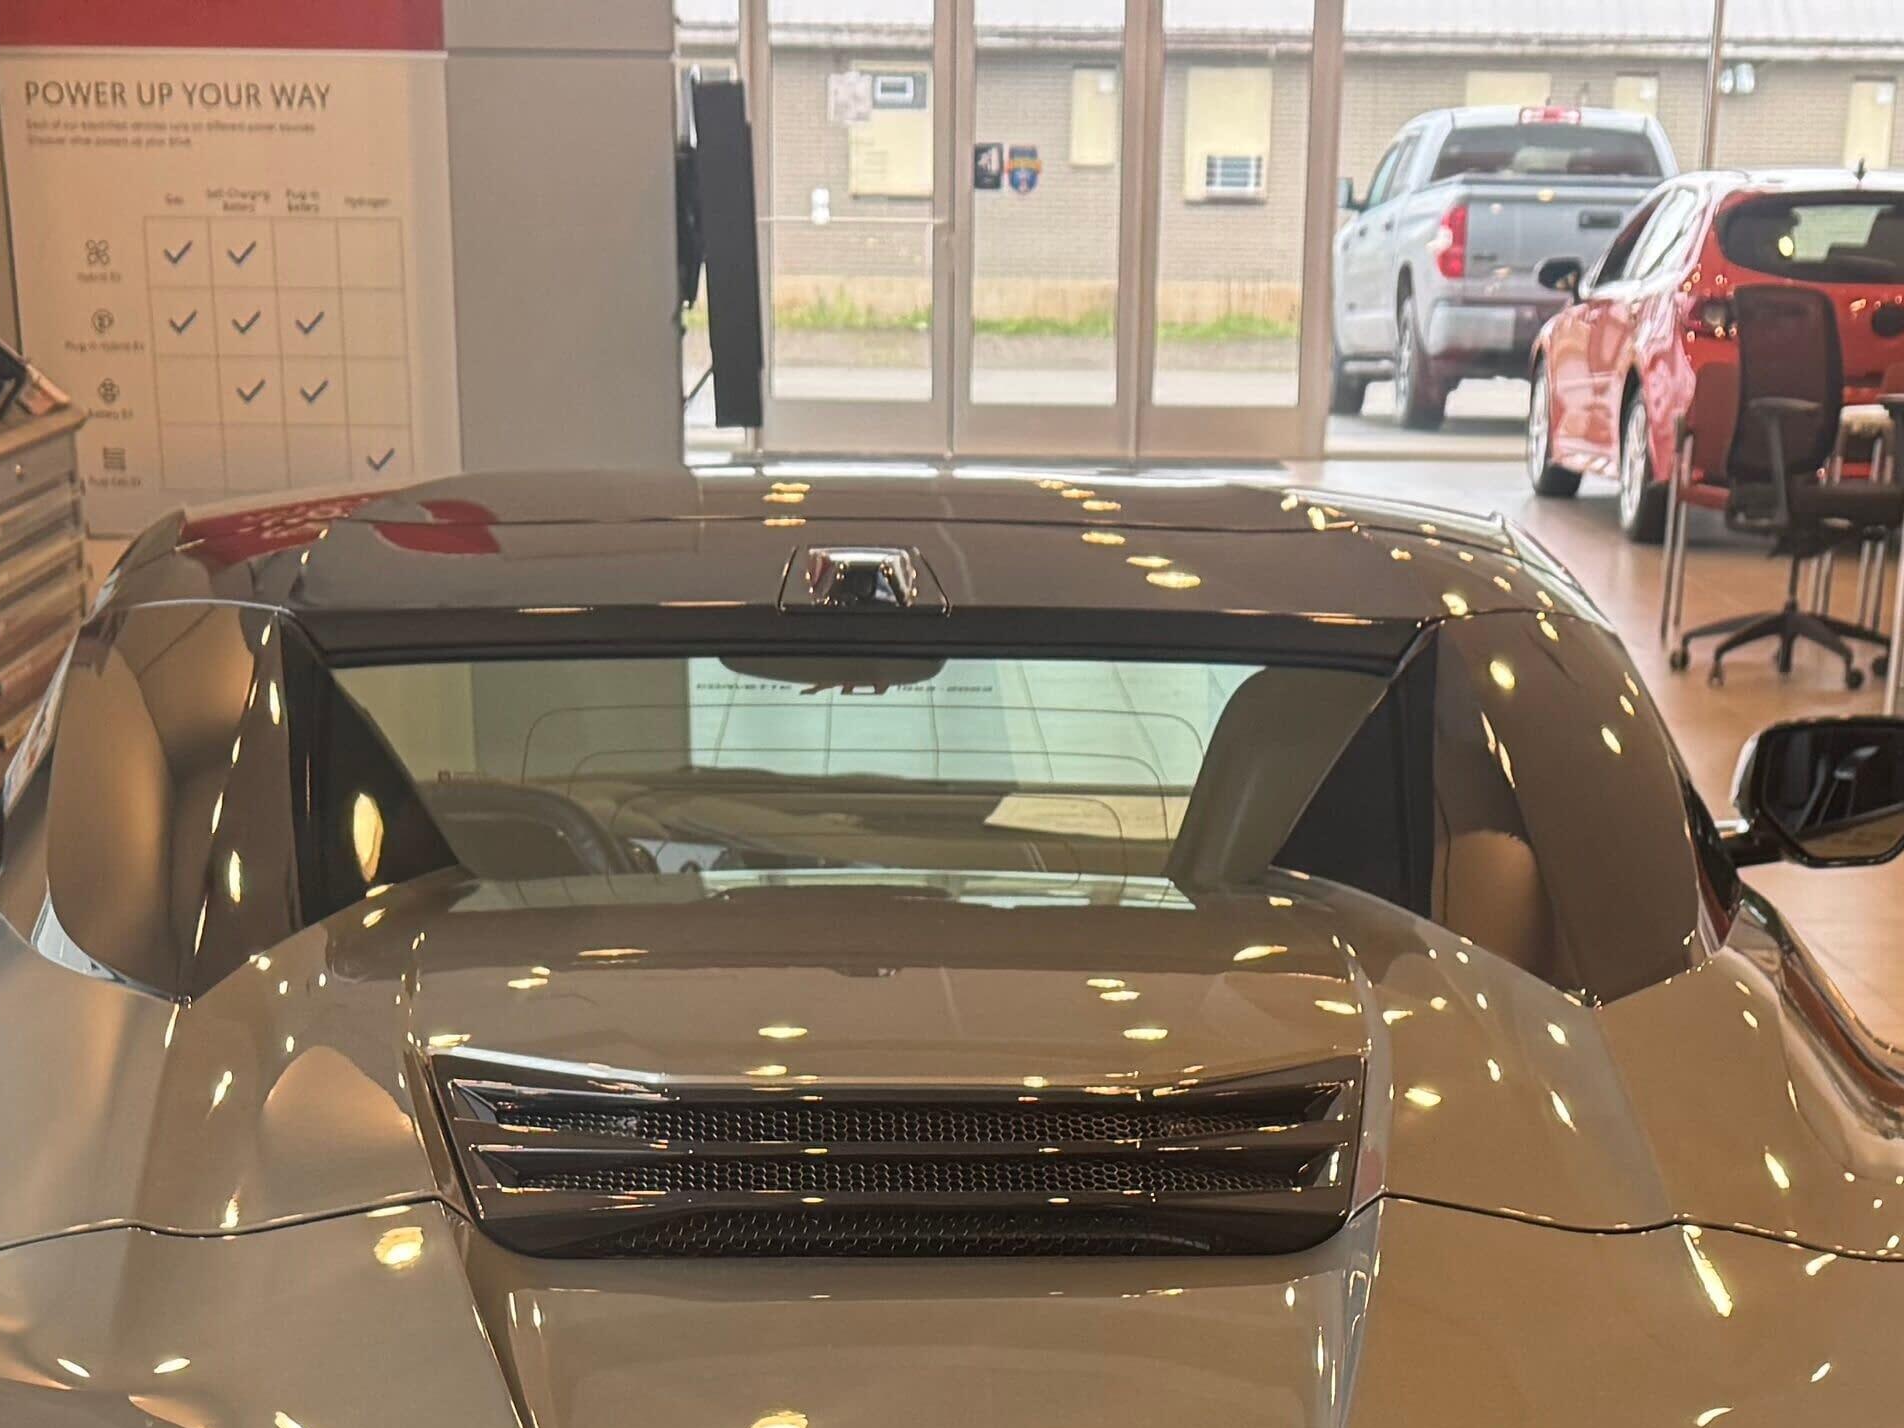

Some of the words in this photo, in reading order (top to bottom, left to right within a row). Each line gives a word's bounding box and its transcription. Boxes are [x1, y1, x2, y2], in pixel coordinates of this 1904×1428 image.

[25, 81, 127, 106] POWER
[137, 82, 173, 107] UP
[182, 82, 261, 109] YOUR
[270, 83, 331, 110] WAY
